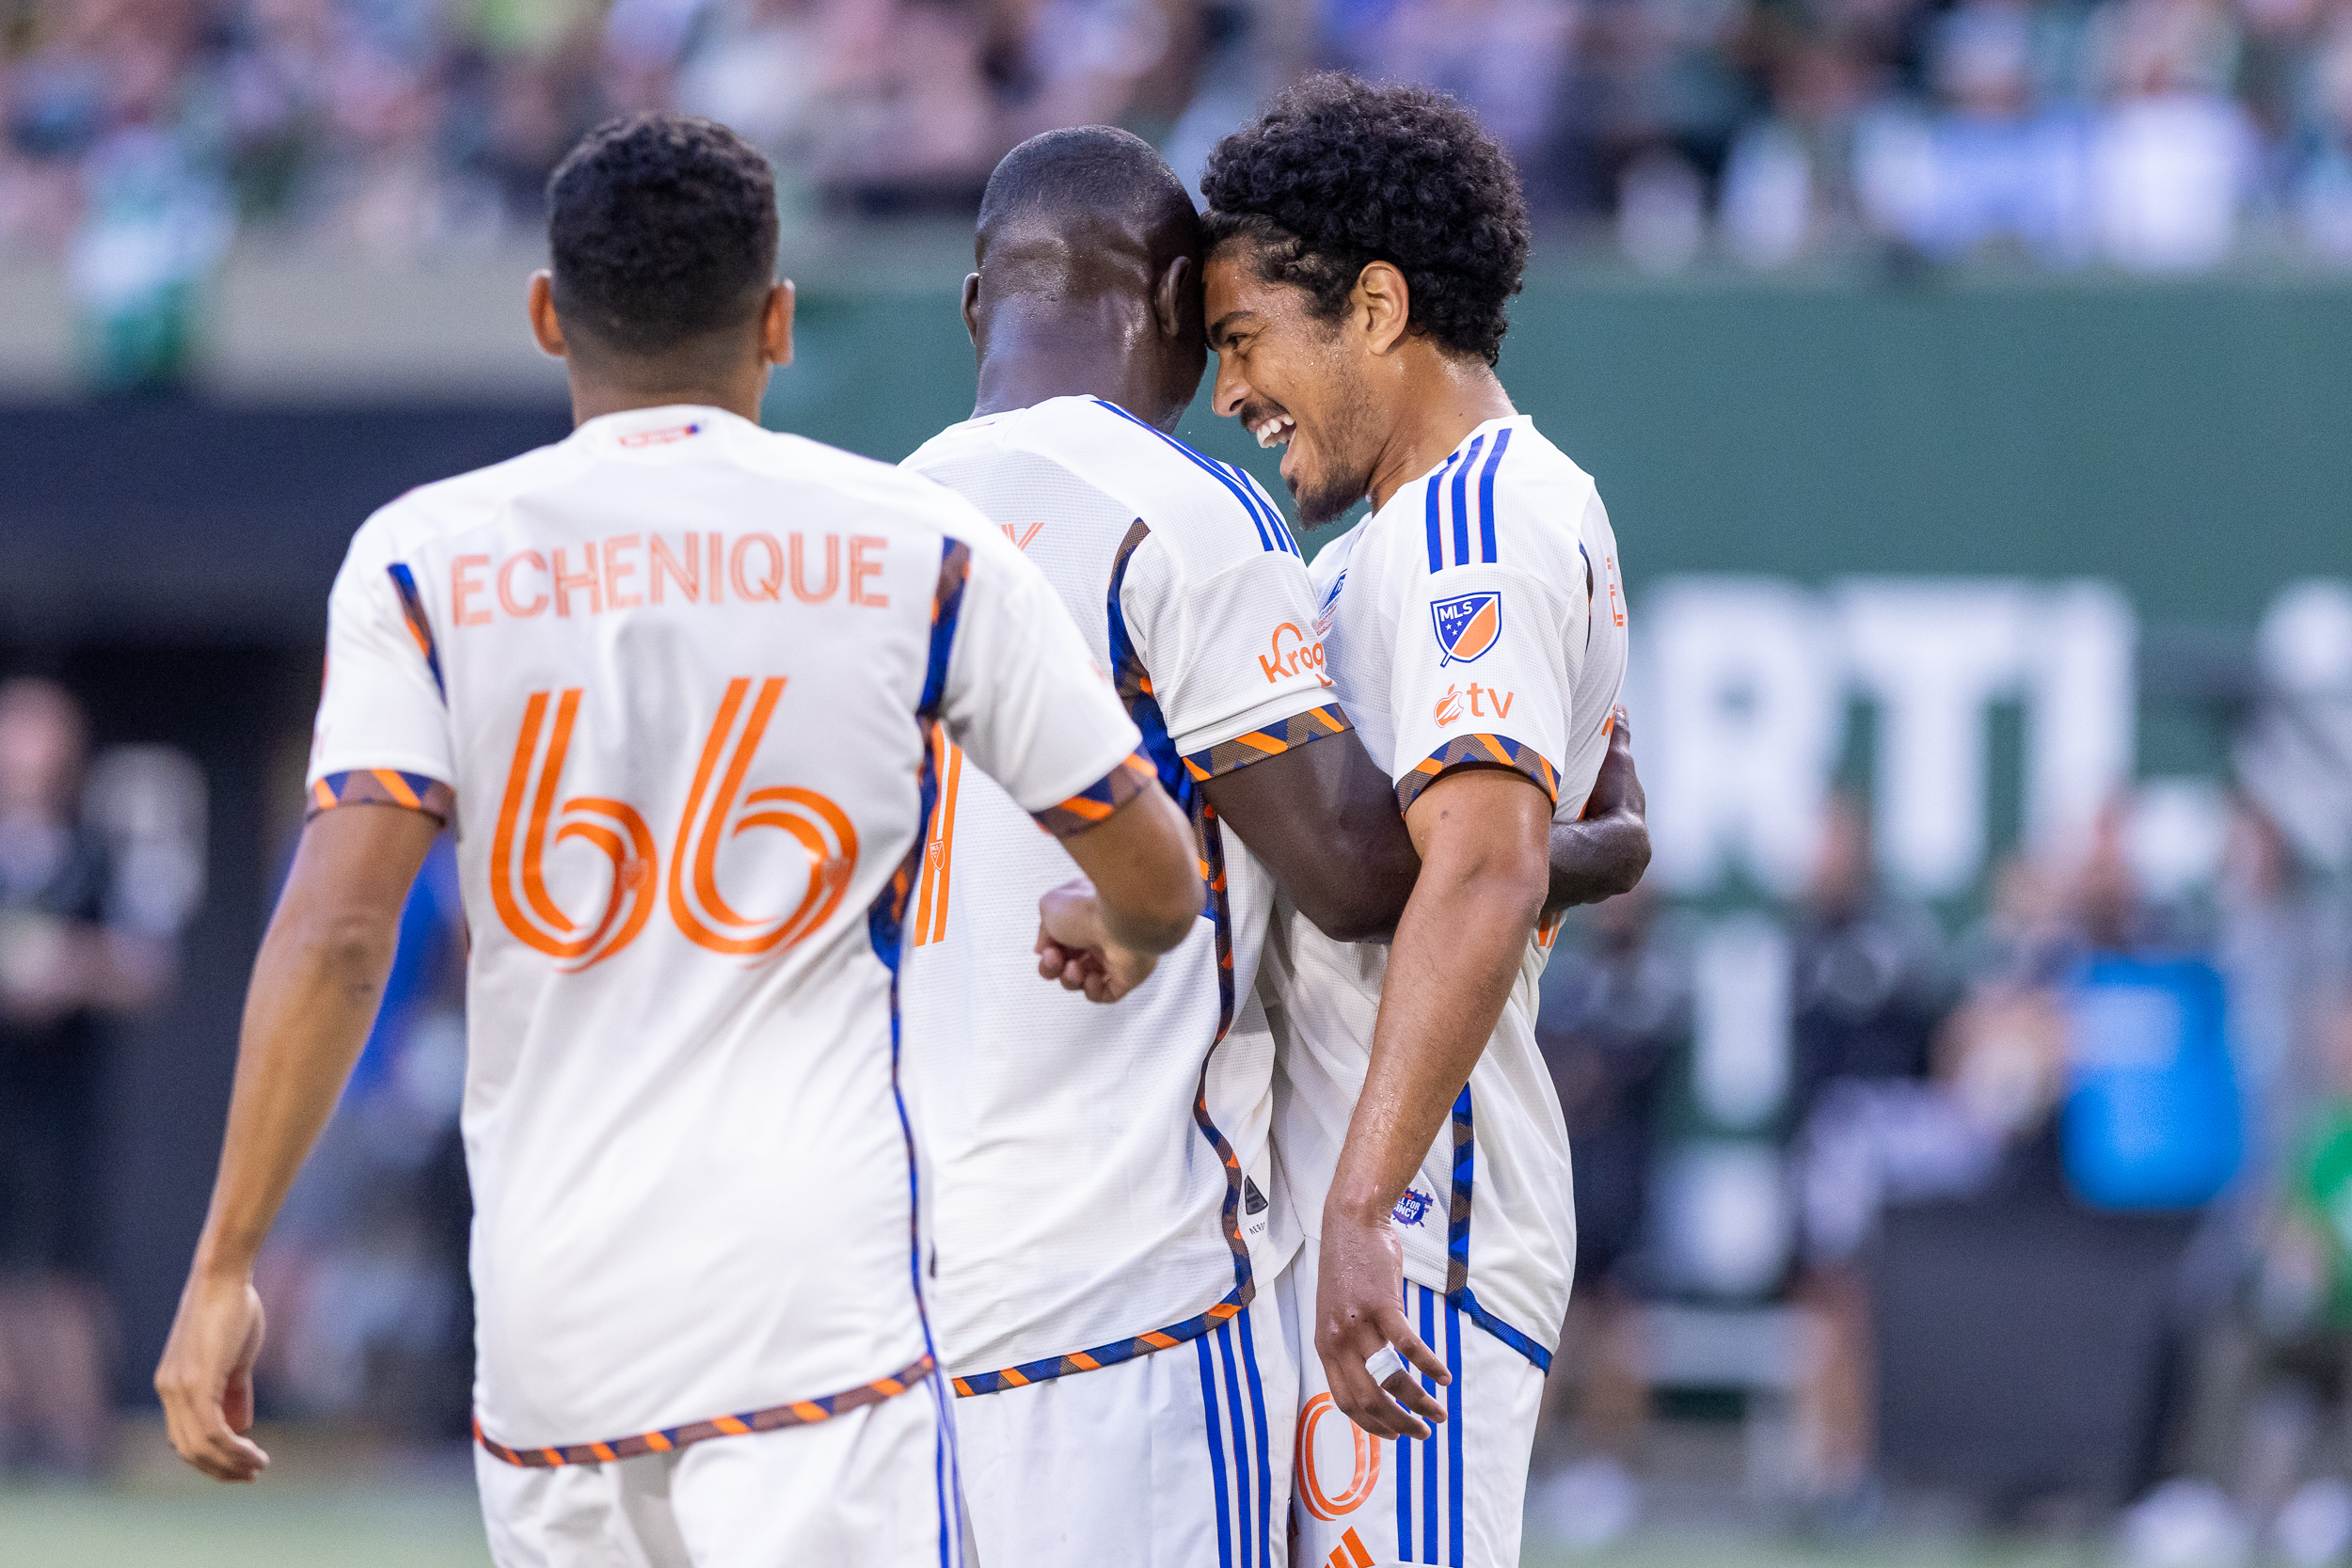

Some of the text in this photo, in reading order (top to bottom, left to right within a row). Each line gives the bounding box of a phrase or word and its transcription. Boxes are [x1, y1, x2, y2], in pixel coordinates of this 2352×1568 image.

[450, 531, 890, 628] ECHENIQUE
[1438, 601, 1473, 622] MLS
[1467, 682, 1514, 720] tv
[490, 675, 858, 974] 66
[1406, 1198, 1421, 1212] FOR
